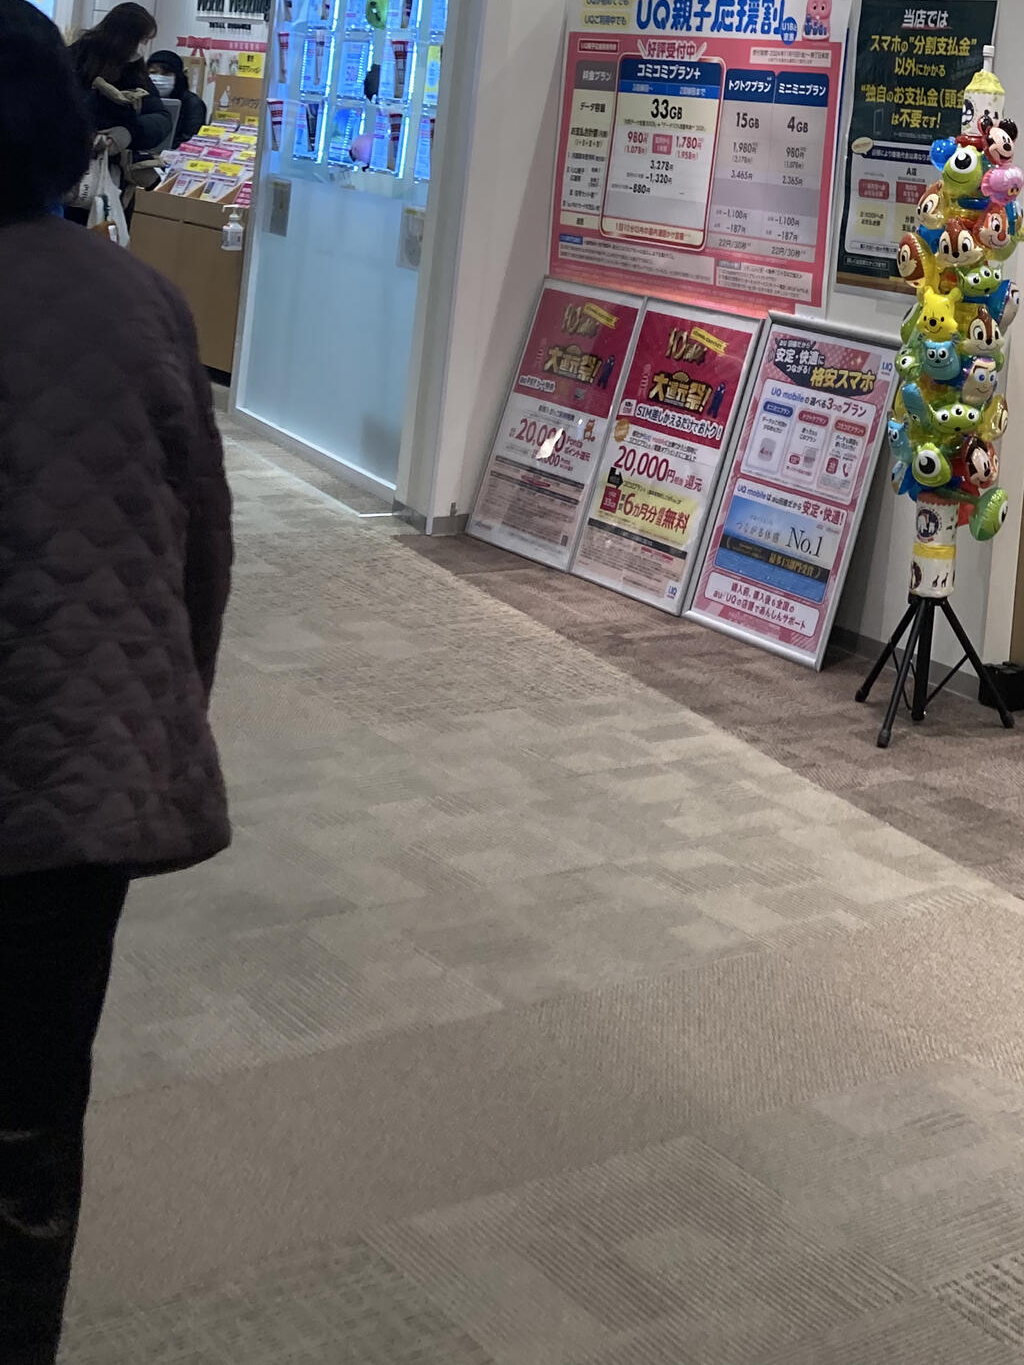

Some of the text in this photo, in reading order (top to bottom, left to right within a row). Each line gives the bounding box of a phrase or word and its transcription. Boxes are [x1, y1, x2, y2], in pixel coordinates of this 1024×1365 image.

[902, 9, 949, 28] 当店では
[646, 40, 697, 60] 好評受付中
[894, 57, 946, 77] 以外にかかる
[728, 79, 772, 94] トクトクプラン
[778, 82, 827, 97] ミニミニプラン
[650, 98, 683, 120] 33GB
[735, 112, 760, 130] 15GB
[787, 116, 809, 134] 4GB
[891, 109, 941, 128] は不要です!
[882, 361, 893, 372] UQ
[810, 366, 876, 392] 格安スマホ
[771, 387, 782, 397] UQ
[737, 485, 747, 494] UQ
[785, 526, 823, 557] No.1
